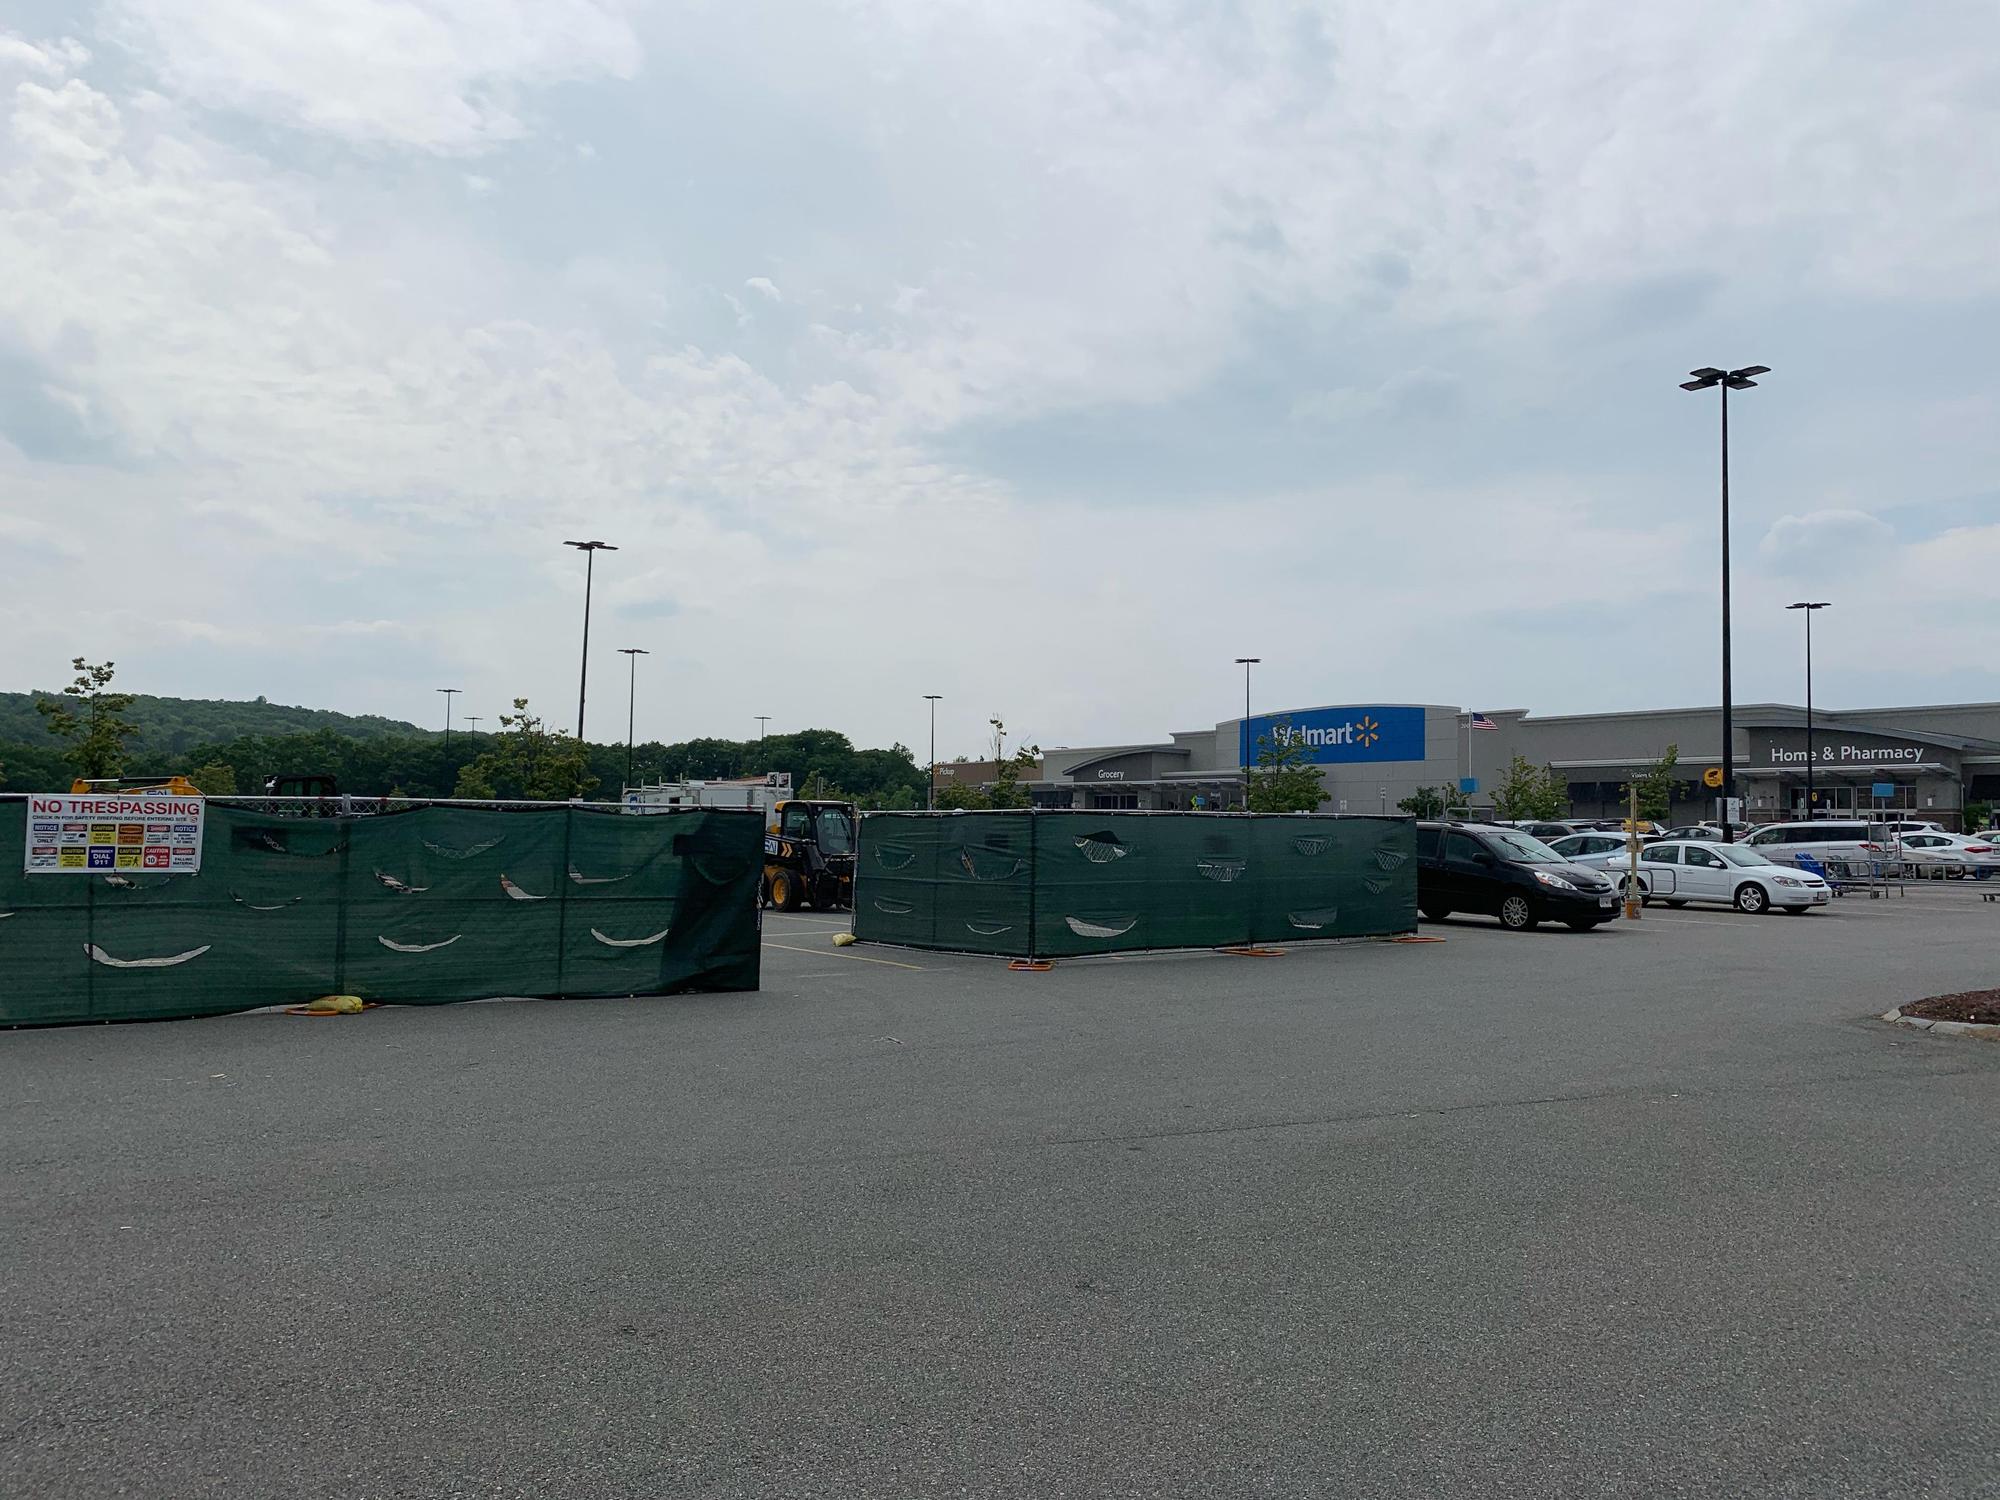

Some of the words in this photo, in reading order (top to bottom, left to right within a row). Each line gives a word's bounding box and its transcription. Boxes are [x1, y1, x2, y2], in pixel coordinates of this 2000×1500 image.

[1273, 722, 1353, 747] Walmart
[1771, 748, 1817, 762] Home
[1822, 746, 1834, 761] &
[1840, 745, 1923, 763] Pharmacy
[1098, 769, 1125, 781] Grocery
[32, 800, 62, 814] NO
[68, 801, 200, 816] TRESPASSING
